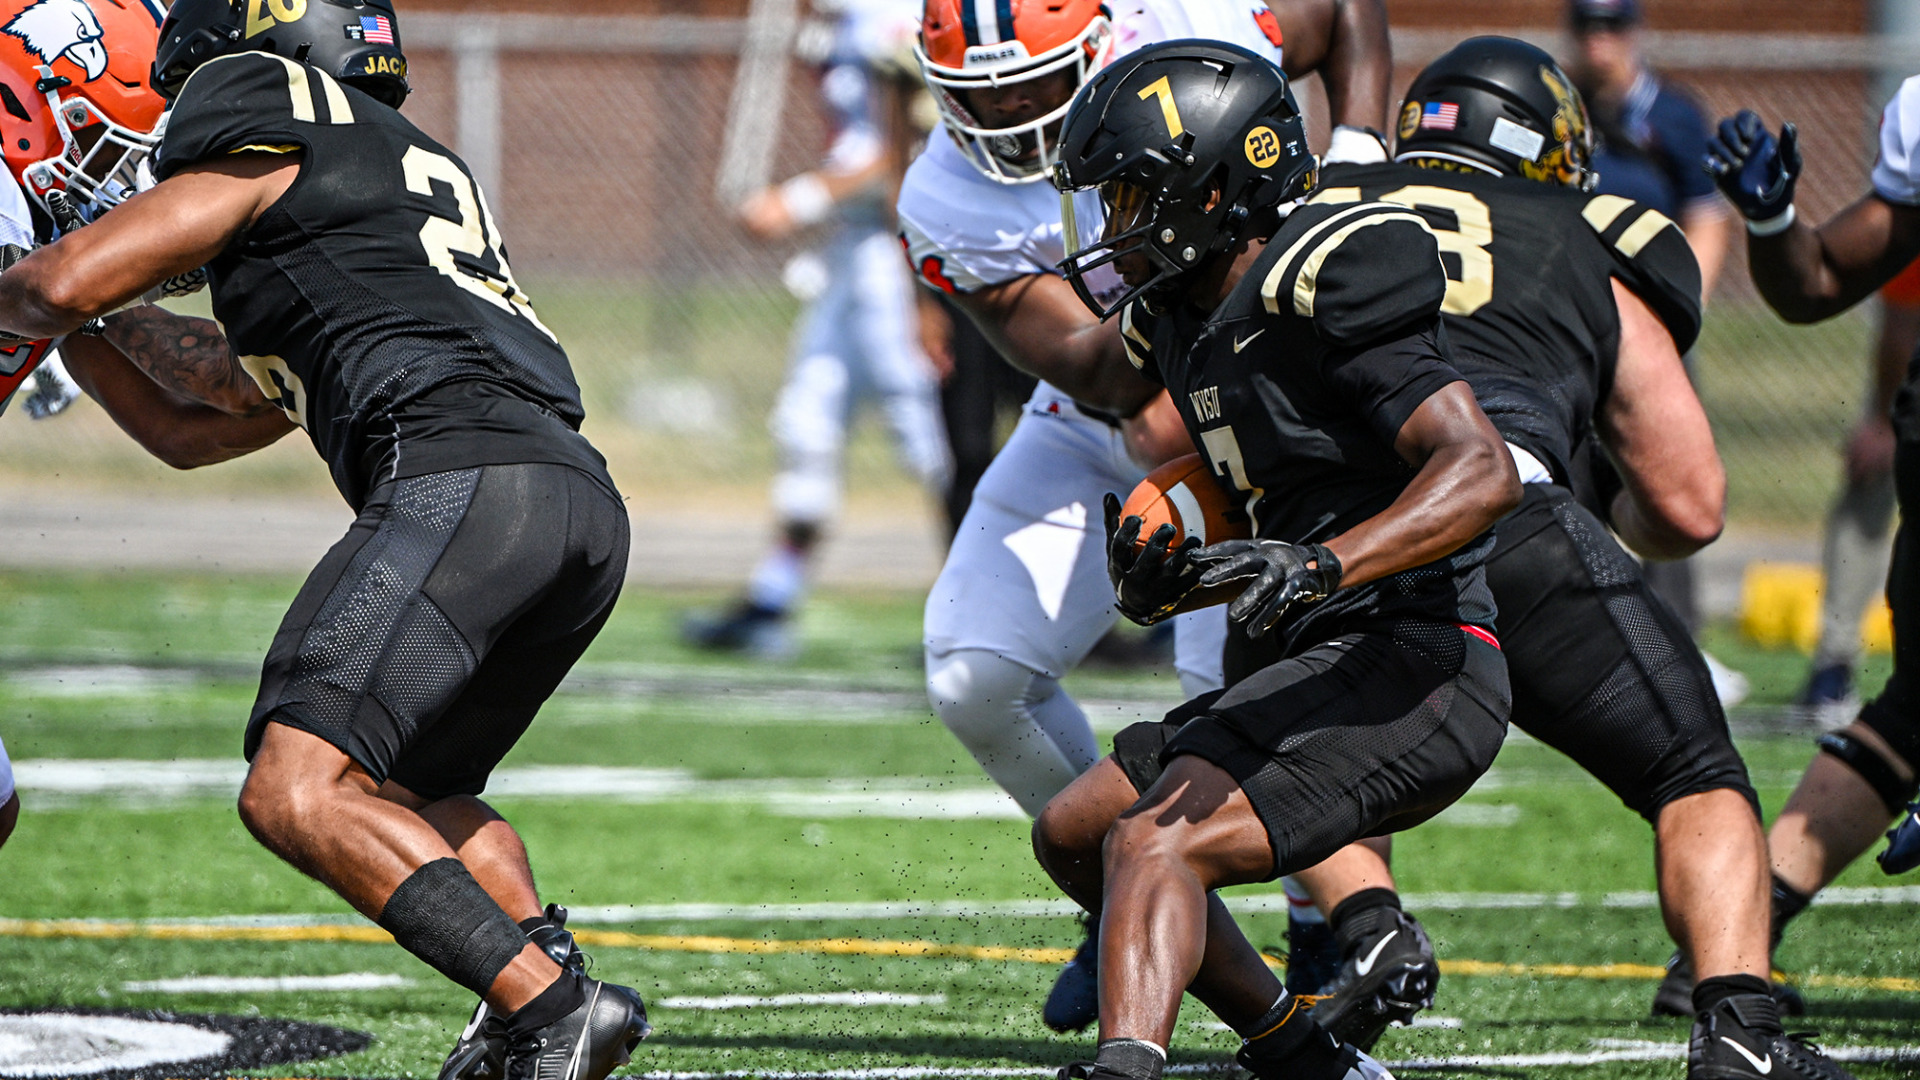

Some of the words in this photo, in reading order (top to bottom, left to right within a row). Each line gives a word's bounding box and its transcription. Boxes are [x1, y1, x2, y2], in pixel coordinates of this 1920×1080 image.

[969, 48, 1015, 62] EAGLES
[1137, 75, 1184, 140] 7
[1248, 131, 1278, 162] 22
[1189, 385, 1221, 423] WVSU
[1200, 425, 1264, 540] 7
